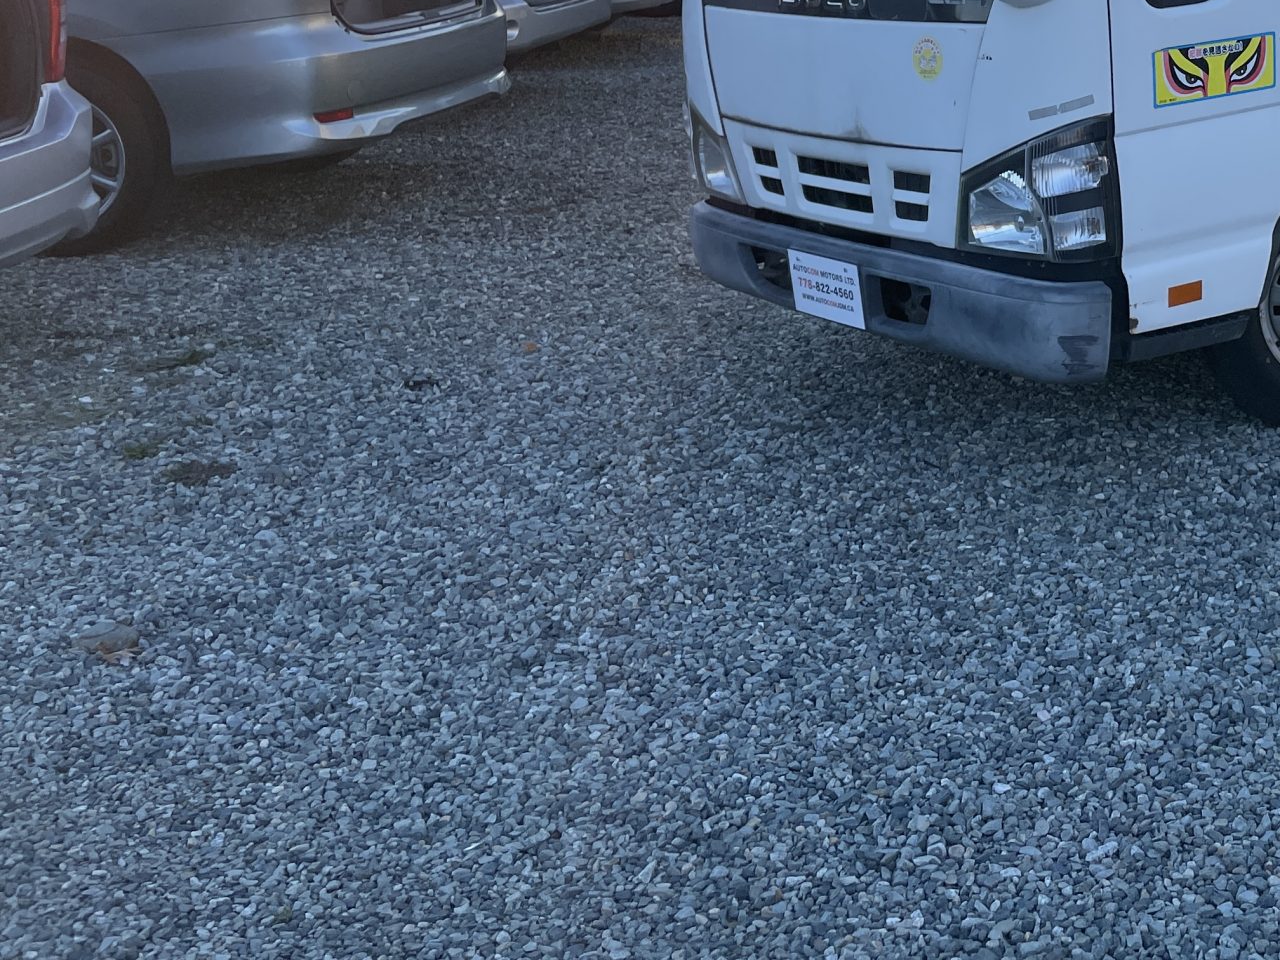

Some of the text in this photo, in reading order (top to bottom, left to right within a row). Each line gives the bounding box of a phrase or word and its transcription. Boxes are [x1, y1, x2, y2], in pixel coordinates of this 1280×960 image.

[793, 264, 819, 276] AUTOCOM
[820, 270, 843, 282] MOTORS
[798, 277, 854, 300] 778-822-4560
